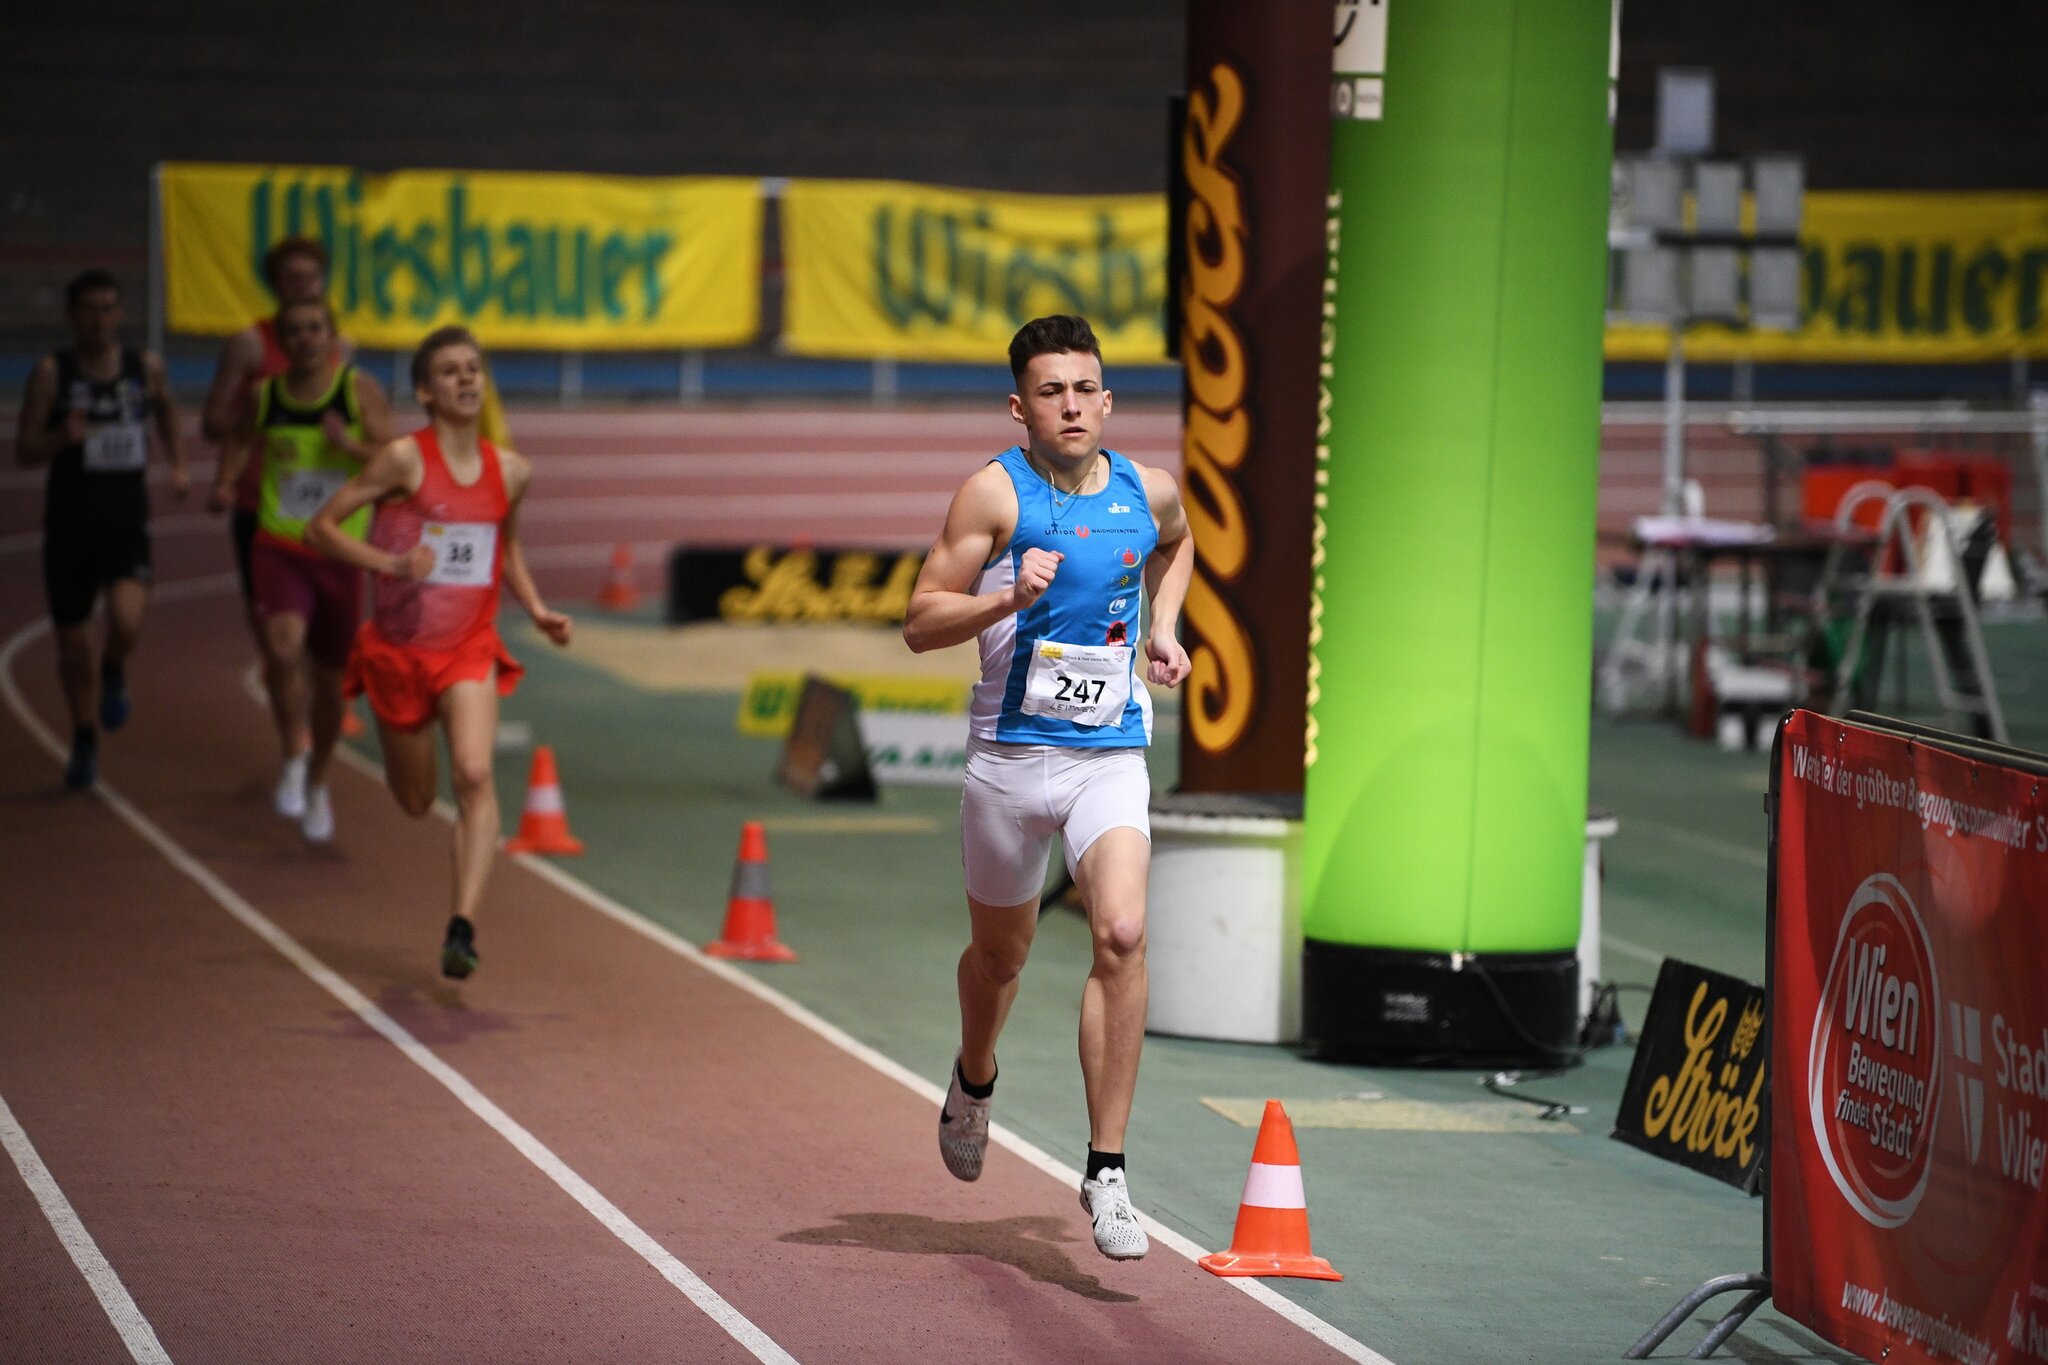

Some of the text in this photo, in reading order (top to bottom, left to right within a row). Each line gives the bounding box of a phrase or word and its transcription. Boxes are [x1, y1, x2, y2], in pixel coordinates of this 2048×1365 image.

[251, 170, 676, 322] Wiesbauer
[448, 542, 474, 563] 38
[1049, 703, 1096, 714] LEITNER
[1055, 676, 1106, 704] 247
[1856, 768, 1906, 810] größten
[1844, 937, 1919, 1056] Wien
[1643, 981, 1764, 1169] Ströck
[1847, 1041, 1924, 1125] Bewegung
[1834, 1089, 1913, 1160] findet Stadt
